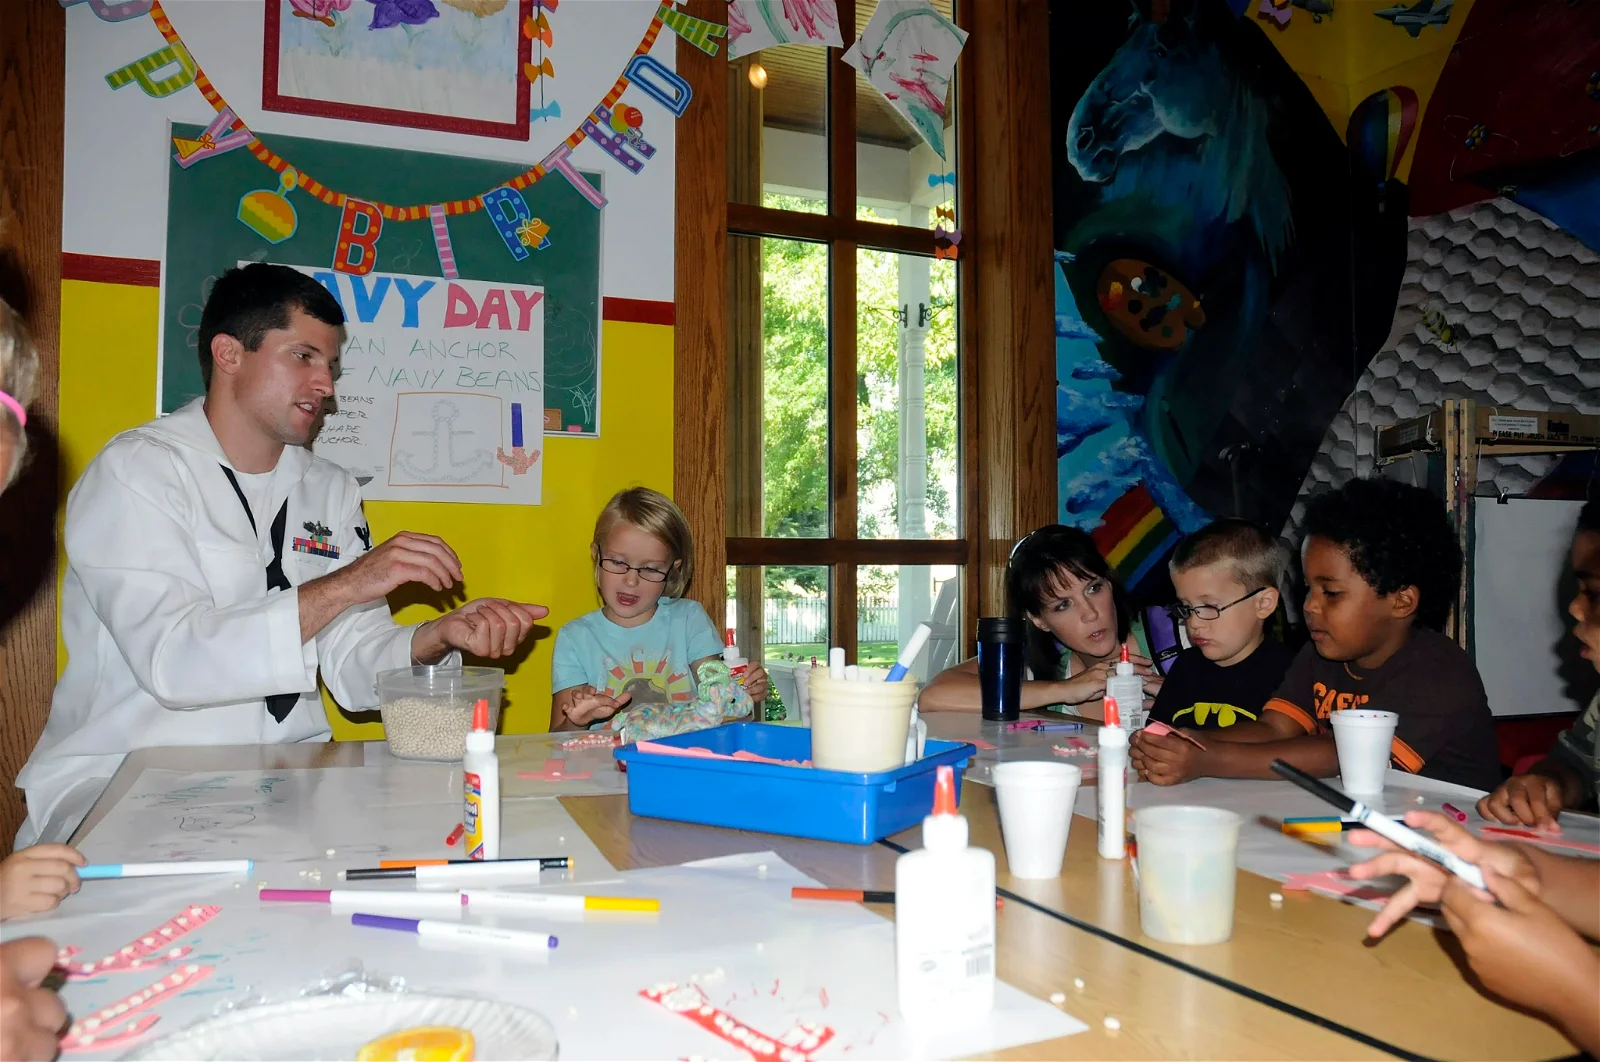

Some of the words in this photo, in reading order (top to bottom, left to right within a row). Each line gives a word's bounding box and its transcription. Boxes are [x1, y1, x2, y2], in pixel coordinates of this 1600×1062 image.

[443, 282, 544, 331] DAY
[344, 335, 386, 356] AN
[409, 339, 517, 361] ANCHOR
[367, 366, 445, 390] NAVY
[456, 366, 542, 393] BEANS
[339, 395, 375, 405] BEANS
